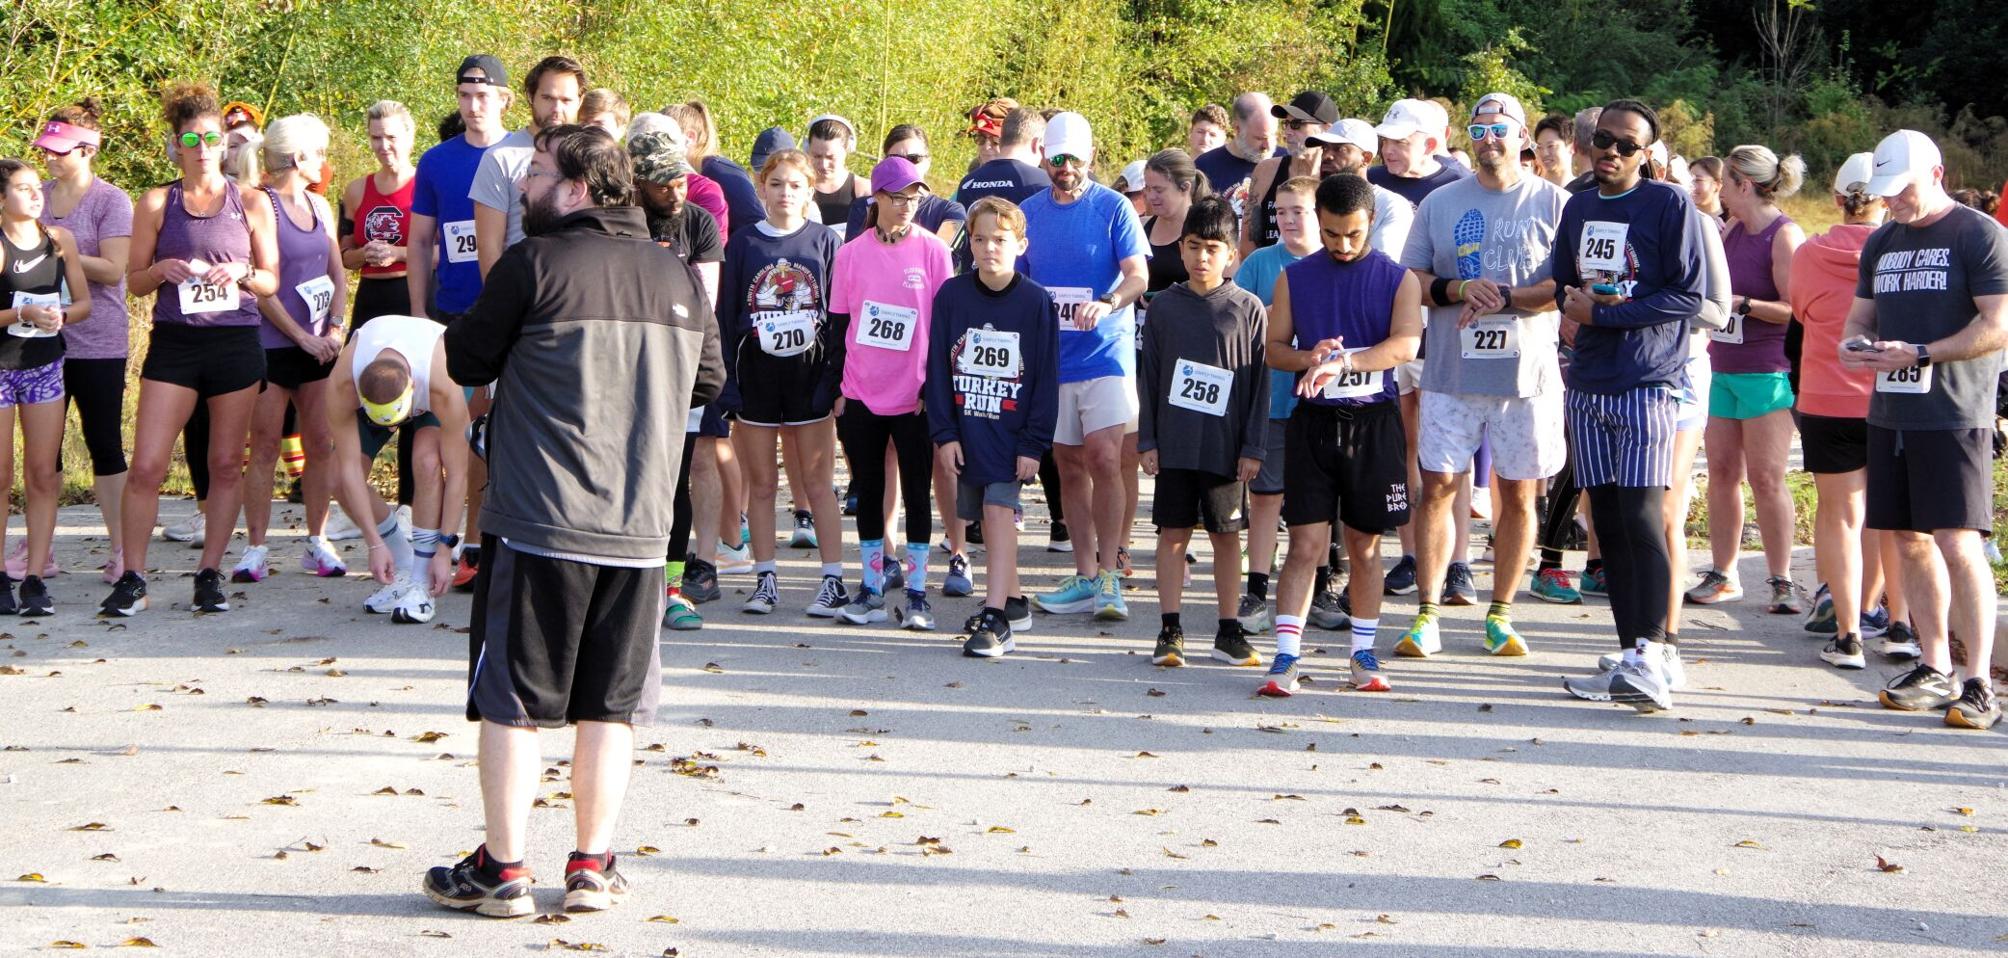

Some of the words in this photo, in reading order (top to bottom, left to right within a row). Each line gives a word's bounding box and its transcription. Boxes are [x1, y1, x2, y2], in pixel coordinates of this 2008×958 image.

[971, 180, 1015, 189] HONDA
[1492, 216, 1534, 242] RUN
[456, 234, 478, 254] 29
[1585, 237, 1616, 260] 245
[1484, 245, 1535, 272] CLUB
[1876, 250, 1916, 272] NOBODY
[1915, 248, 1950, 267] CARES.
[191, 283, 228, 303] 254
[1874, 273, 1902, 294] WORK
[1903, 271, 1947, 291] HARDER!
[313, 290, 330, 312] 273
[772, 328, 805, 350] 270
[868, 317, 906, 341] 268
[1474, 330, 1507, 350] 227
[973, 345, 1010, 368] 269
[1886, 365, 1922, 383] 285
[952, 375, 1023, 399] TURKEY
[1180, 377, 1221, 405] 258
[964, 392, 1002, 413] RUN
[1385, 492, 1407, 503] PURE
[1390, 483, 1405, 493] THE
[1387, 501, 1408, 512] BRED
